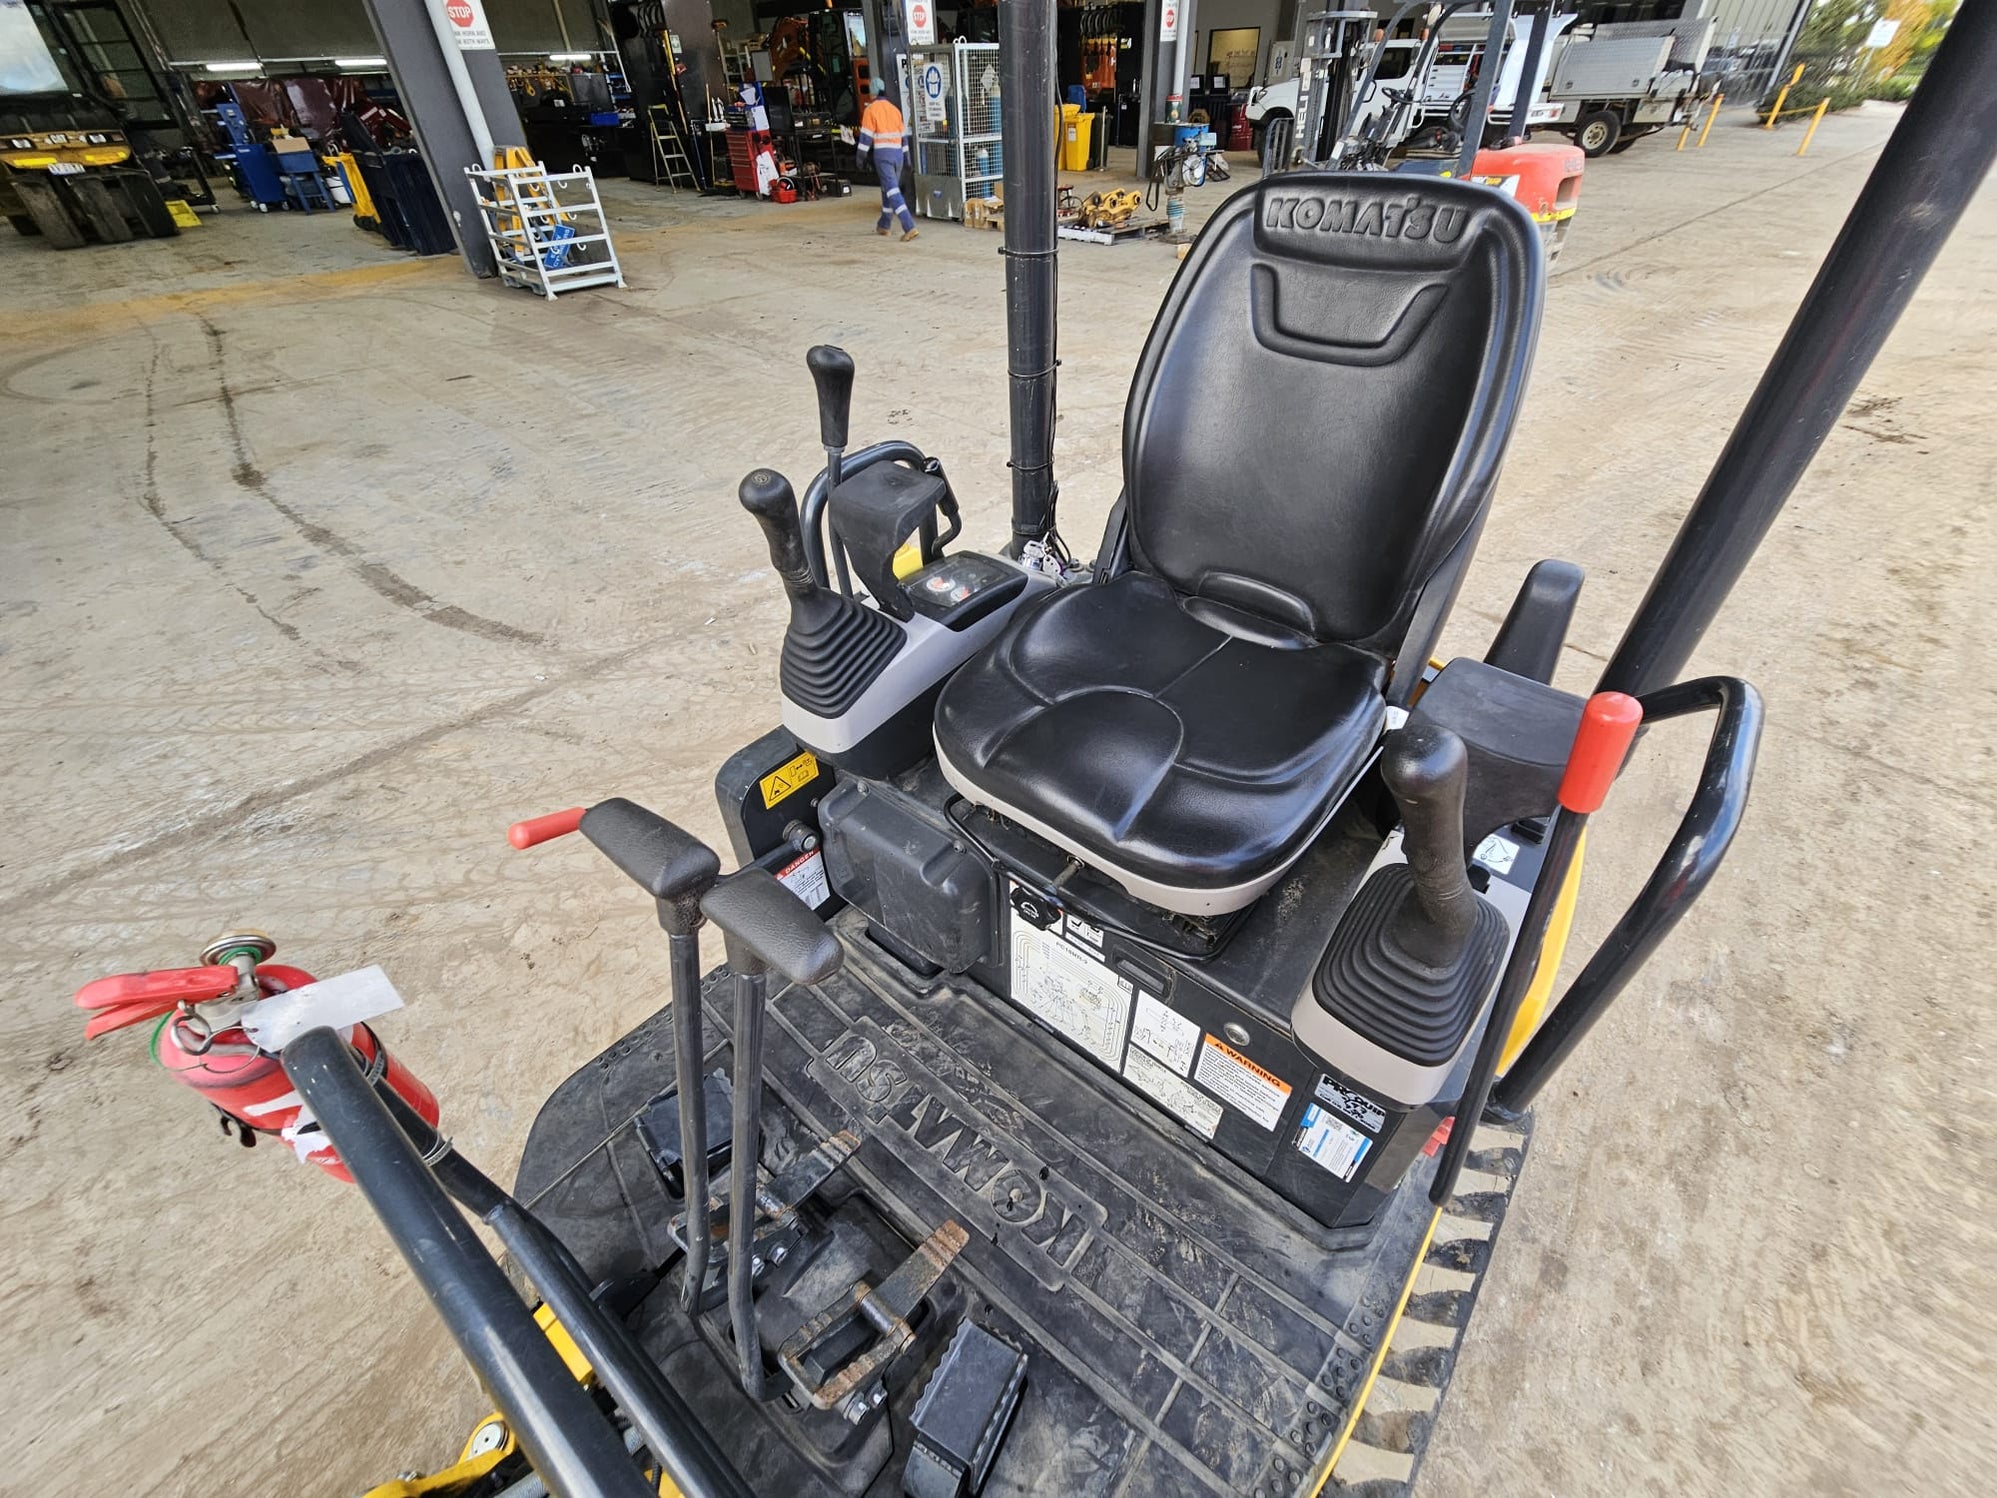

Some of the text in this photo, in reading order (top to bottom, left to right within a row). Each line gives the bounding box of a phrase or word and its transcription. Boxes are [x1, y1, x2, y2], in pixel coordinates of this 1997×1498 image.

[448, 6, 471, 18] STOP
[1295, 95, 1309, 139] HELI
[1265, 195, 1468, 243] KOMATSU
[1226, 1048, 1281, 1087] WARNING
[825, 1036, 1087, 1267] KOMATSU
